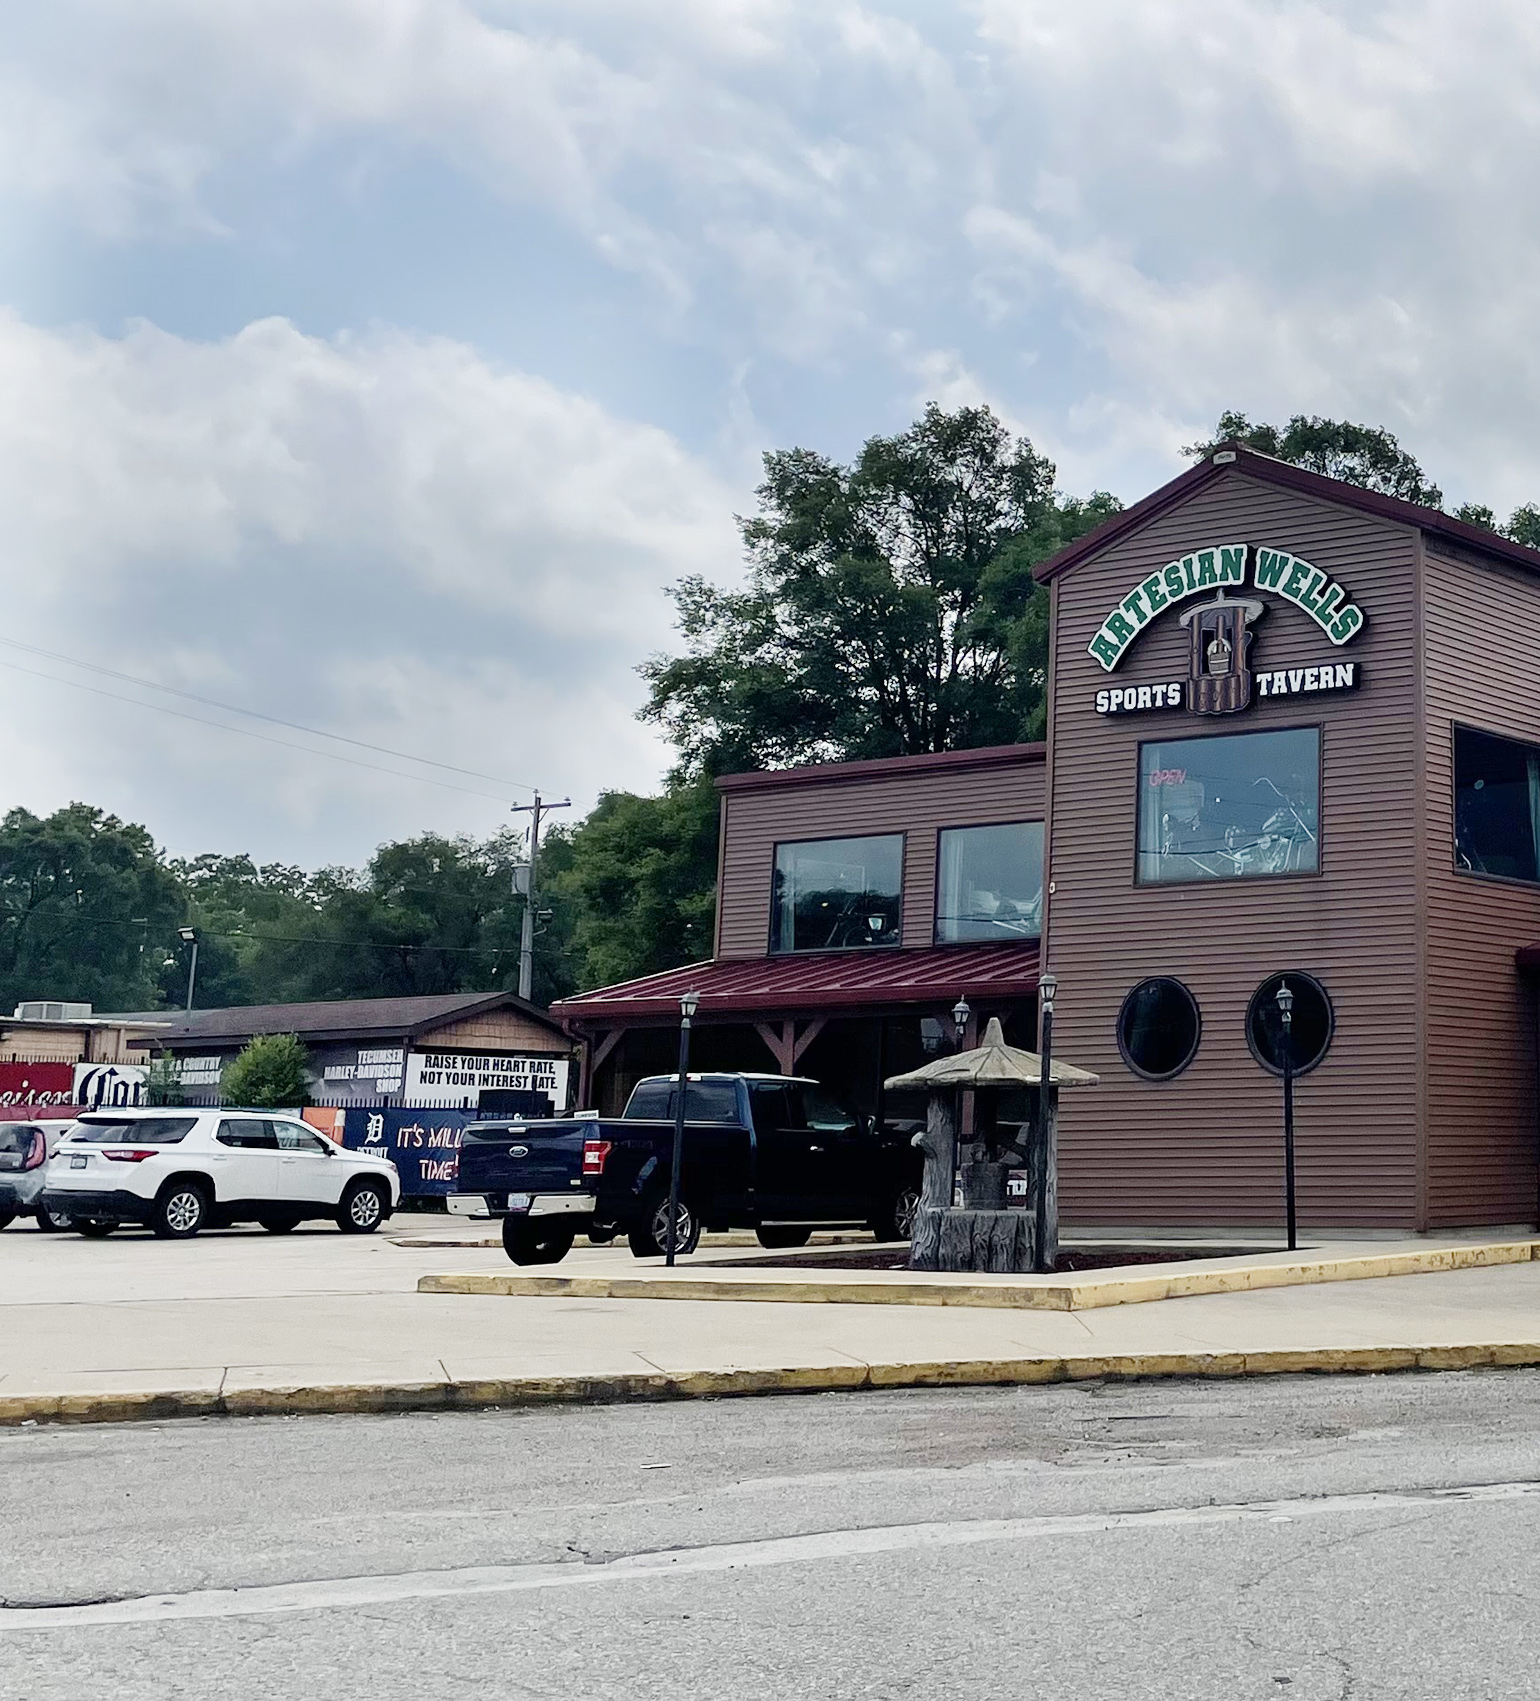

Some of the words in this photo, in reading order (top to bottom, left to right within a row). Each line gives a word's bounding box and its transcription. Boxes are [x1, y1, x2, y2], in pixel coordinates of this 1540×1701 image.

[1087, 544, 1248, 673] ARTESIAN
[1254, 546, 1364, 645] WELLS
[1096, 683, 1181, 713] SPORTS
[1256, 663, 1355, 696] TAVERN
[1150, 768, 1187, 787] OPEN
[323, 1063, 403, 1080] HARLEY-DAVIDSON
[424, 1055, 458, 1070] RAISE
[460, 1057, 490, 1071] YOUR
[492, 1059, 527, 1073] HEART
[529, 1060, 556, 1075] RATE,
[375, 1078, 402, 1094] SHOP
[419, 1071, 443, 1085] NOT
[445, 1072, 475, 1087] YOUR
[478, 1073, 529, 1089] INTEREST
[397, 1123, 425, 1148] IT'S
[428, 1127, 462, 1148] MILL
[419, 1154, 459, 1181] TIME!
